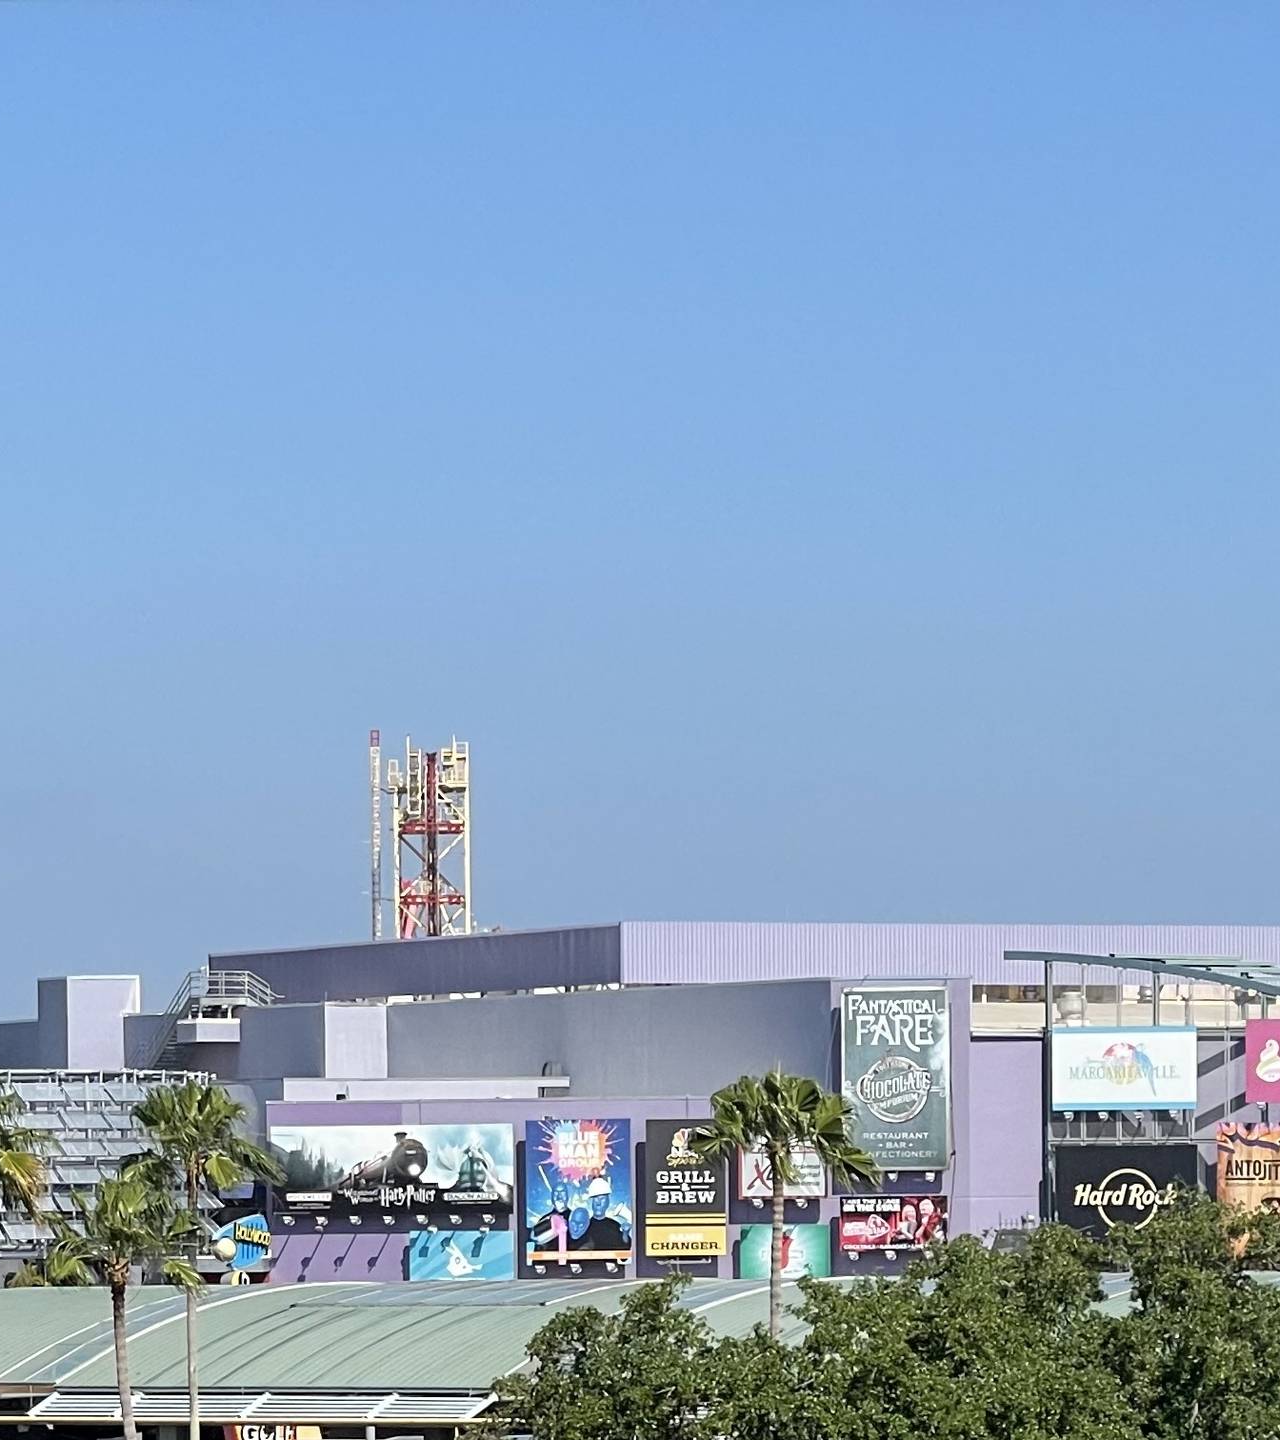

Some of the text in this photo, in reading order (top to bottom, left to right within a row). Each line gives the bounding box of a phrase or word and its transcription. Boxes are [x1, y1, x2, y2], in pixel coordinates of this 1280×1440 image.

[848, 994, 944, 1020] FANTASTICAL
[856, 1014, 934, 1052] FARE
[1069, 1064, 1177, 1080] MARGARITAVLLE
[856, 1068, 931, 1103] CHOCOLATE
[559, 1131, 600, 1144] BLUE
[863, 1132, 929, 1140] RESTAURANT
[559, 1144, 600, 1158] MAN
[886, 1141, 907, 1149] BAR
[868, 1150, 938, 1158] NFECTIONERY
[558, 1158, 599, 1169] GROUP
[656, 1170, 716, 1184] GRILL
[681, 1183, 690, 1192] &
[380, 1185, 436, 1209] Harry Potter
[656, 1191, 716, 1204] BREW
[1073, 1183, 1177, 1210] Hard Rock
